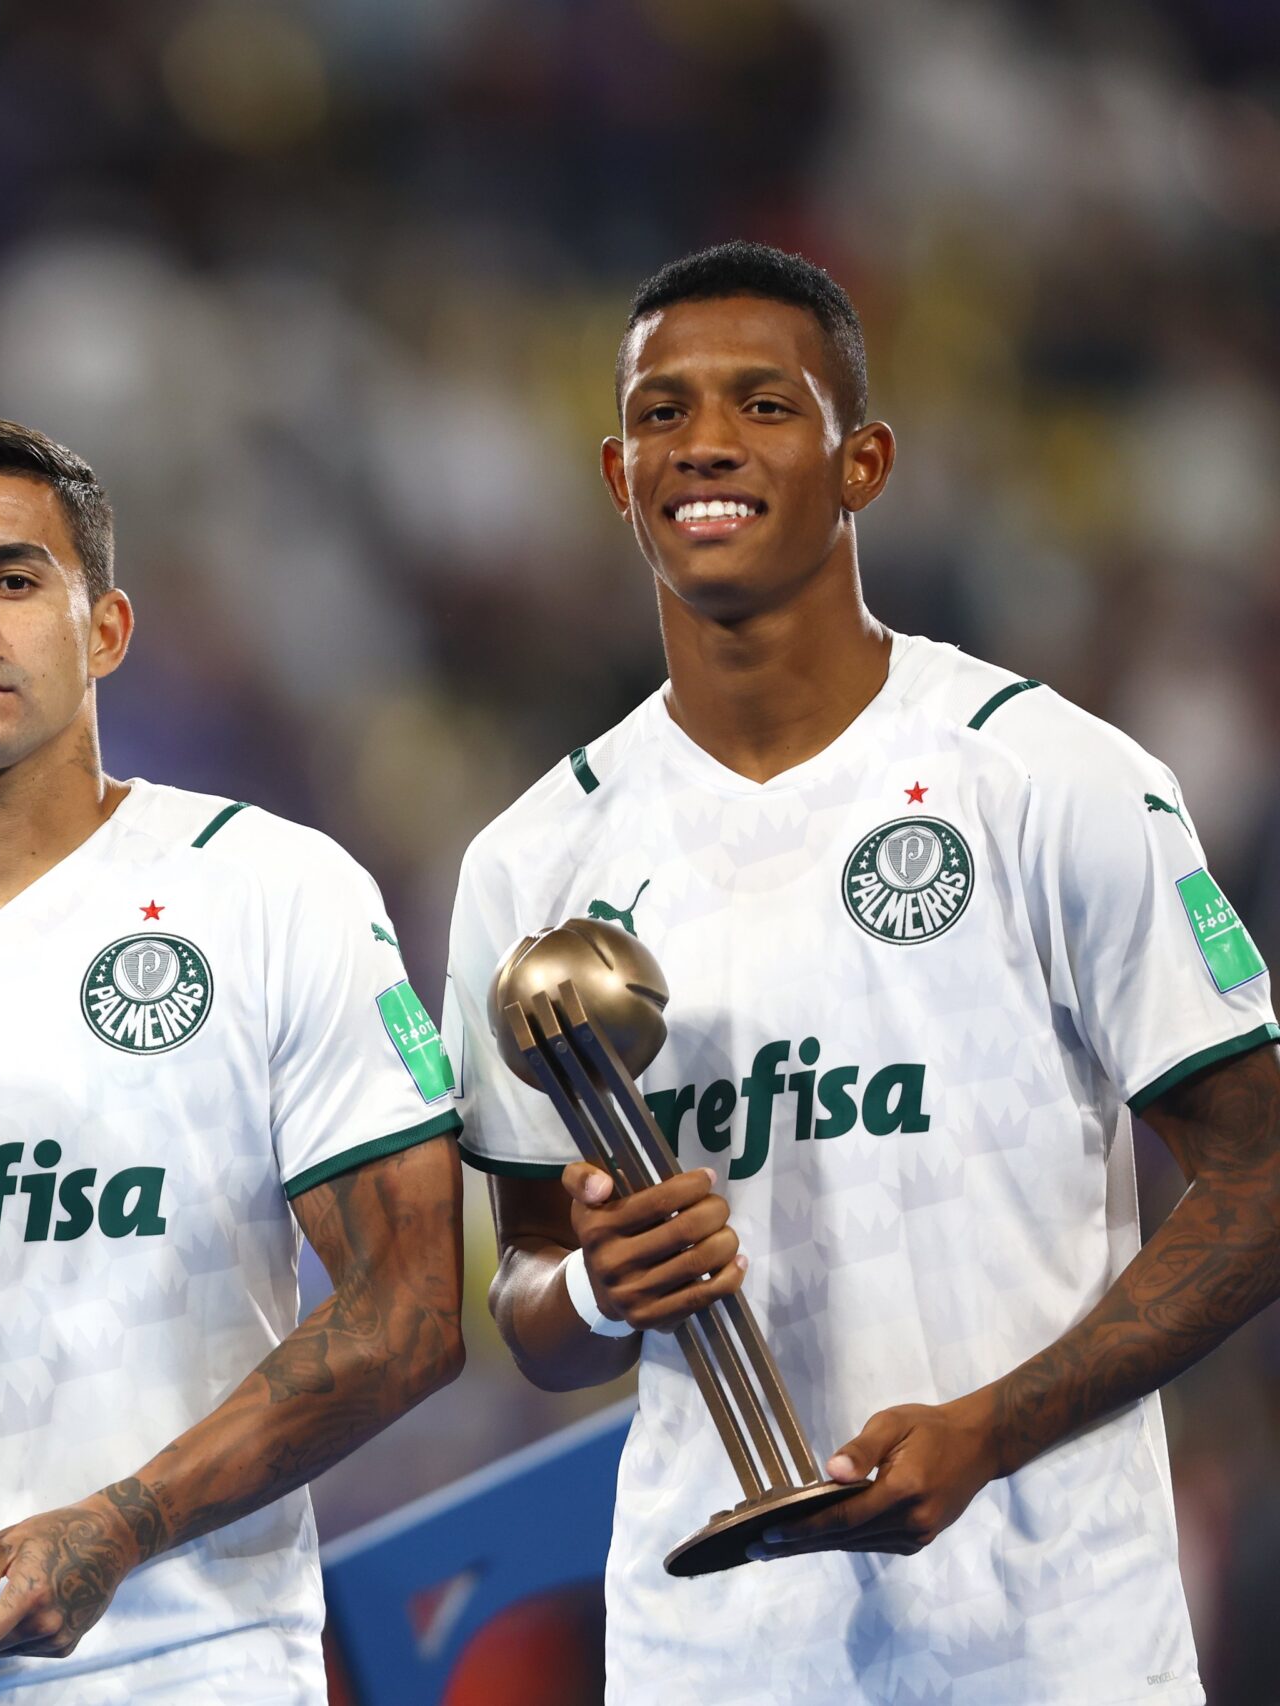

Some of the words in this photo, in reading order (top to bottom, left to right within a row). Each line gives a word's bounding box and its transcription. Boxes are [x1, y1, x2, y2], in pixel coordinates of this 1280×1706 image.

[851, 870, 967, 938] PALMEIRAS
[88, 981, 204, 1048] PALMEIRAS
[642, 1036, 931, 1180] refisa
